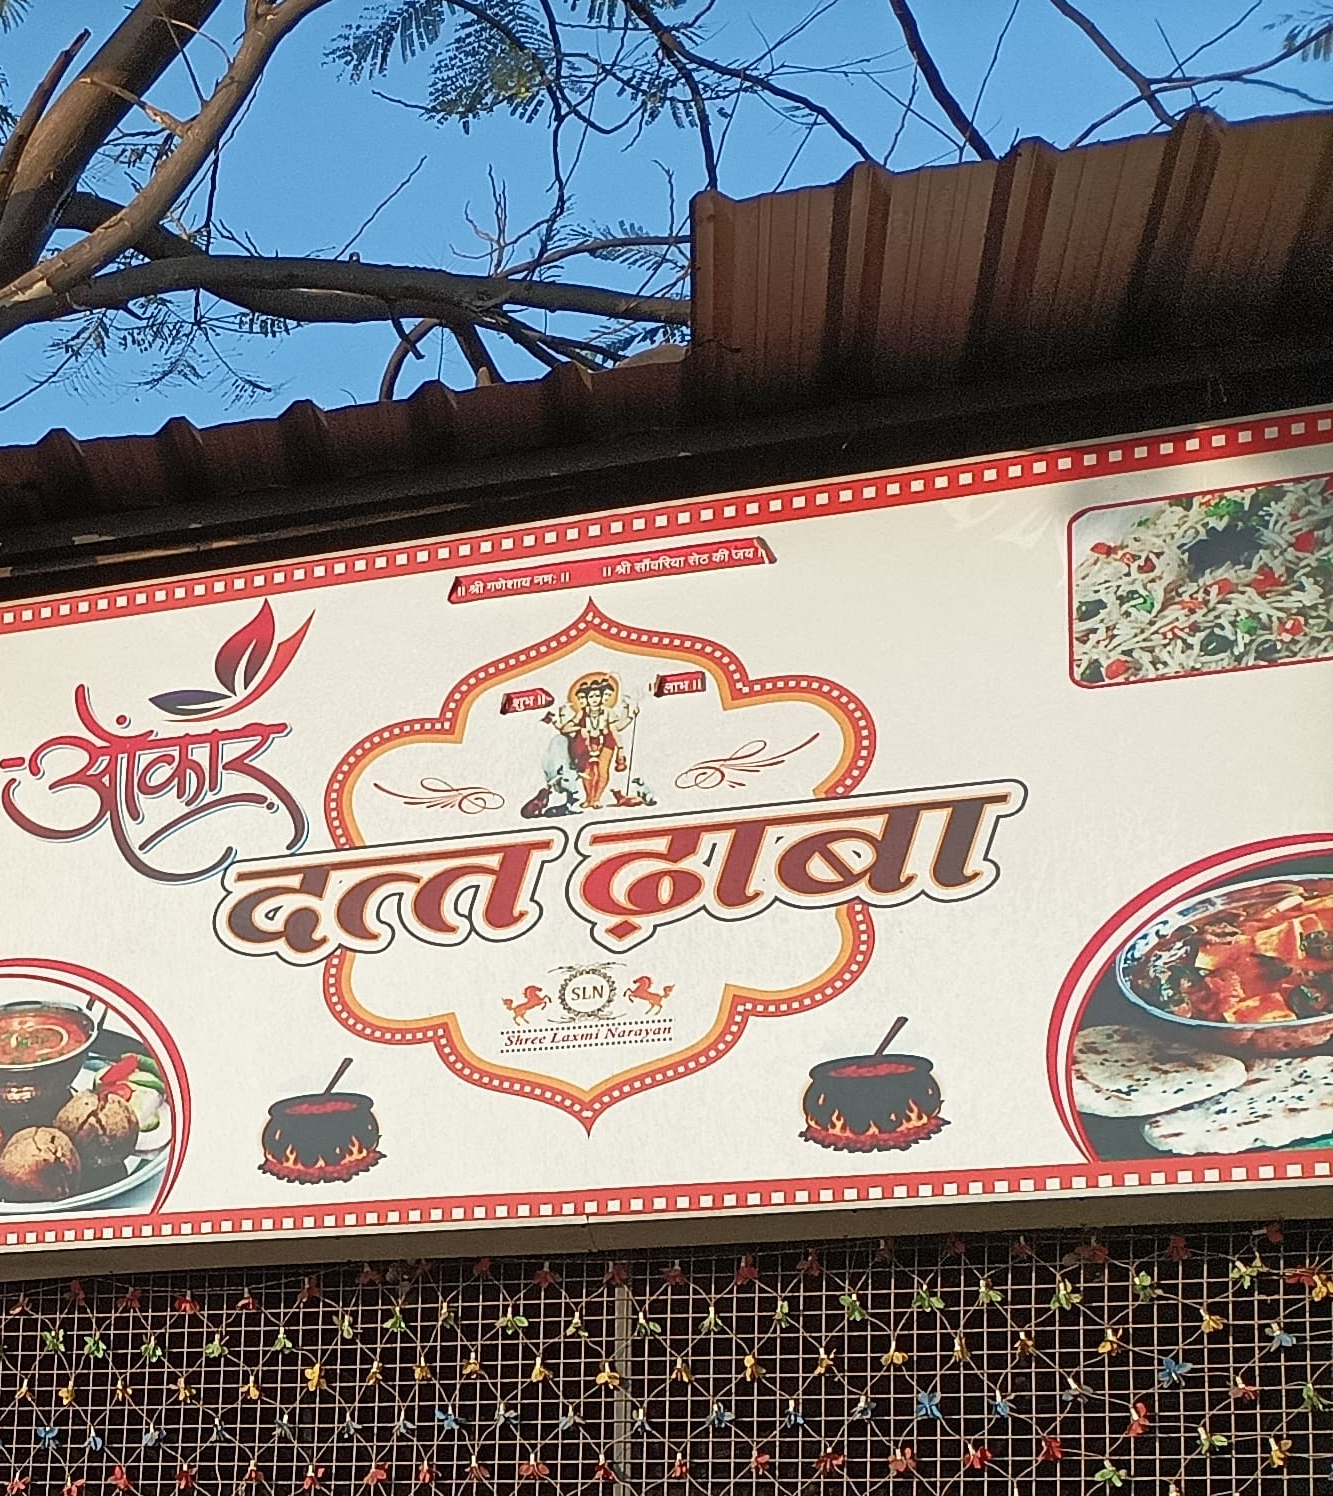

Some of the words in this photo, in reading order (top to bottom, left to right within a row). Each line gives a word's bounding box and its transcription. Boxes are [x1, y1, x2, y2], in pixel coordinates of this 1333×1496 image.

[712, 548, 729, 563] की
[731, 547, 754, 560] जय
[223, 835, 555, 956] दत्त
[571, 984, 605, 1001] SLN
[504, 1033, 546, 1048] Shree
[550, 1029, 600, 1044] Laxmi
[604, 1024, 672, 1043] Narayan
